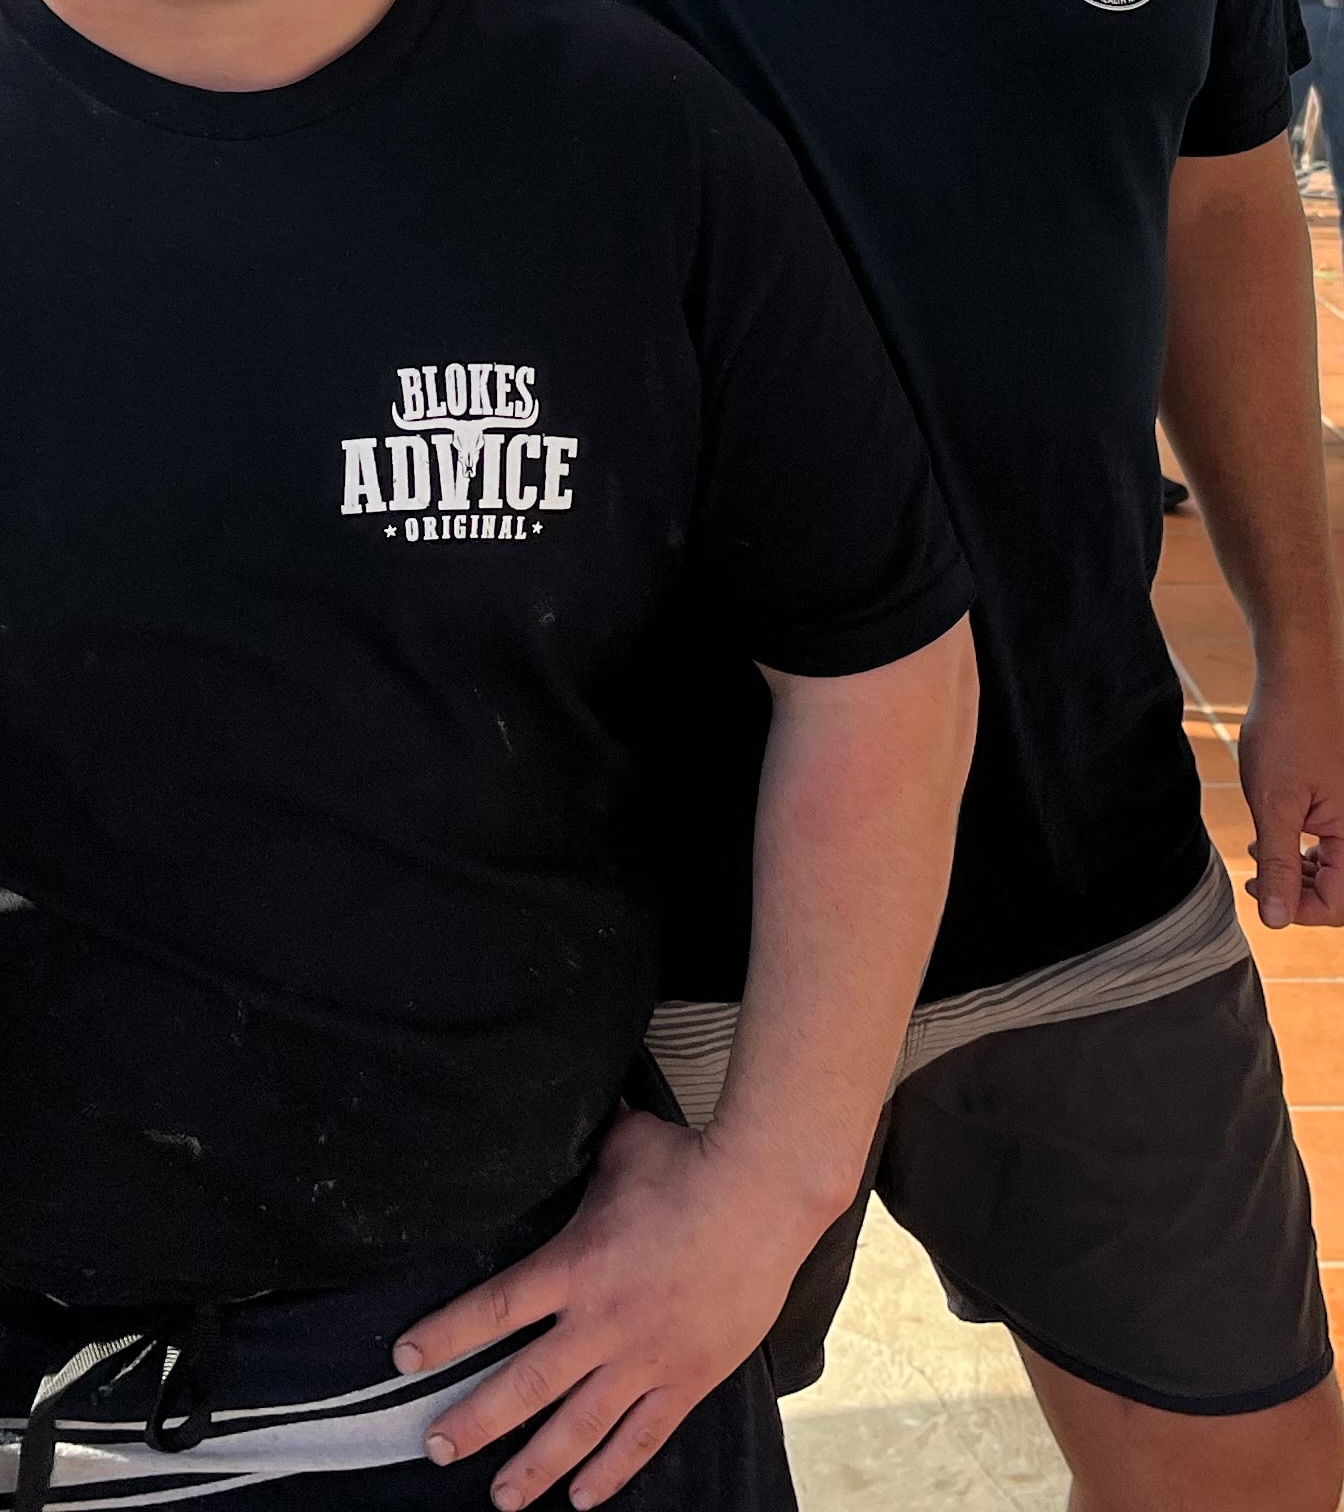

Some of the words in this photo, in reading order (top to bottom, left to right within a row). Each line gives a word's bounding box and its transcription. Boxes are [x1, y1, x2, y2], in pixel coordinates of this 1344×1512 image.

[397, 363, 536, 421] BLOKES
[340, 434, 579, 515] ADVICE
[405, 515, 527, 542] ORIGINAL
